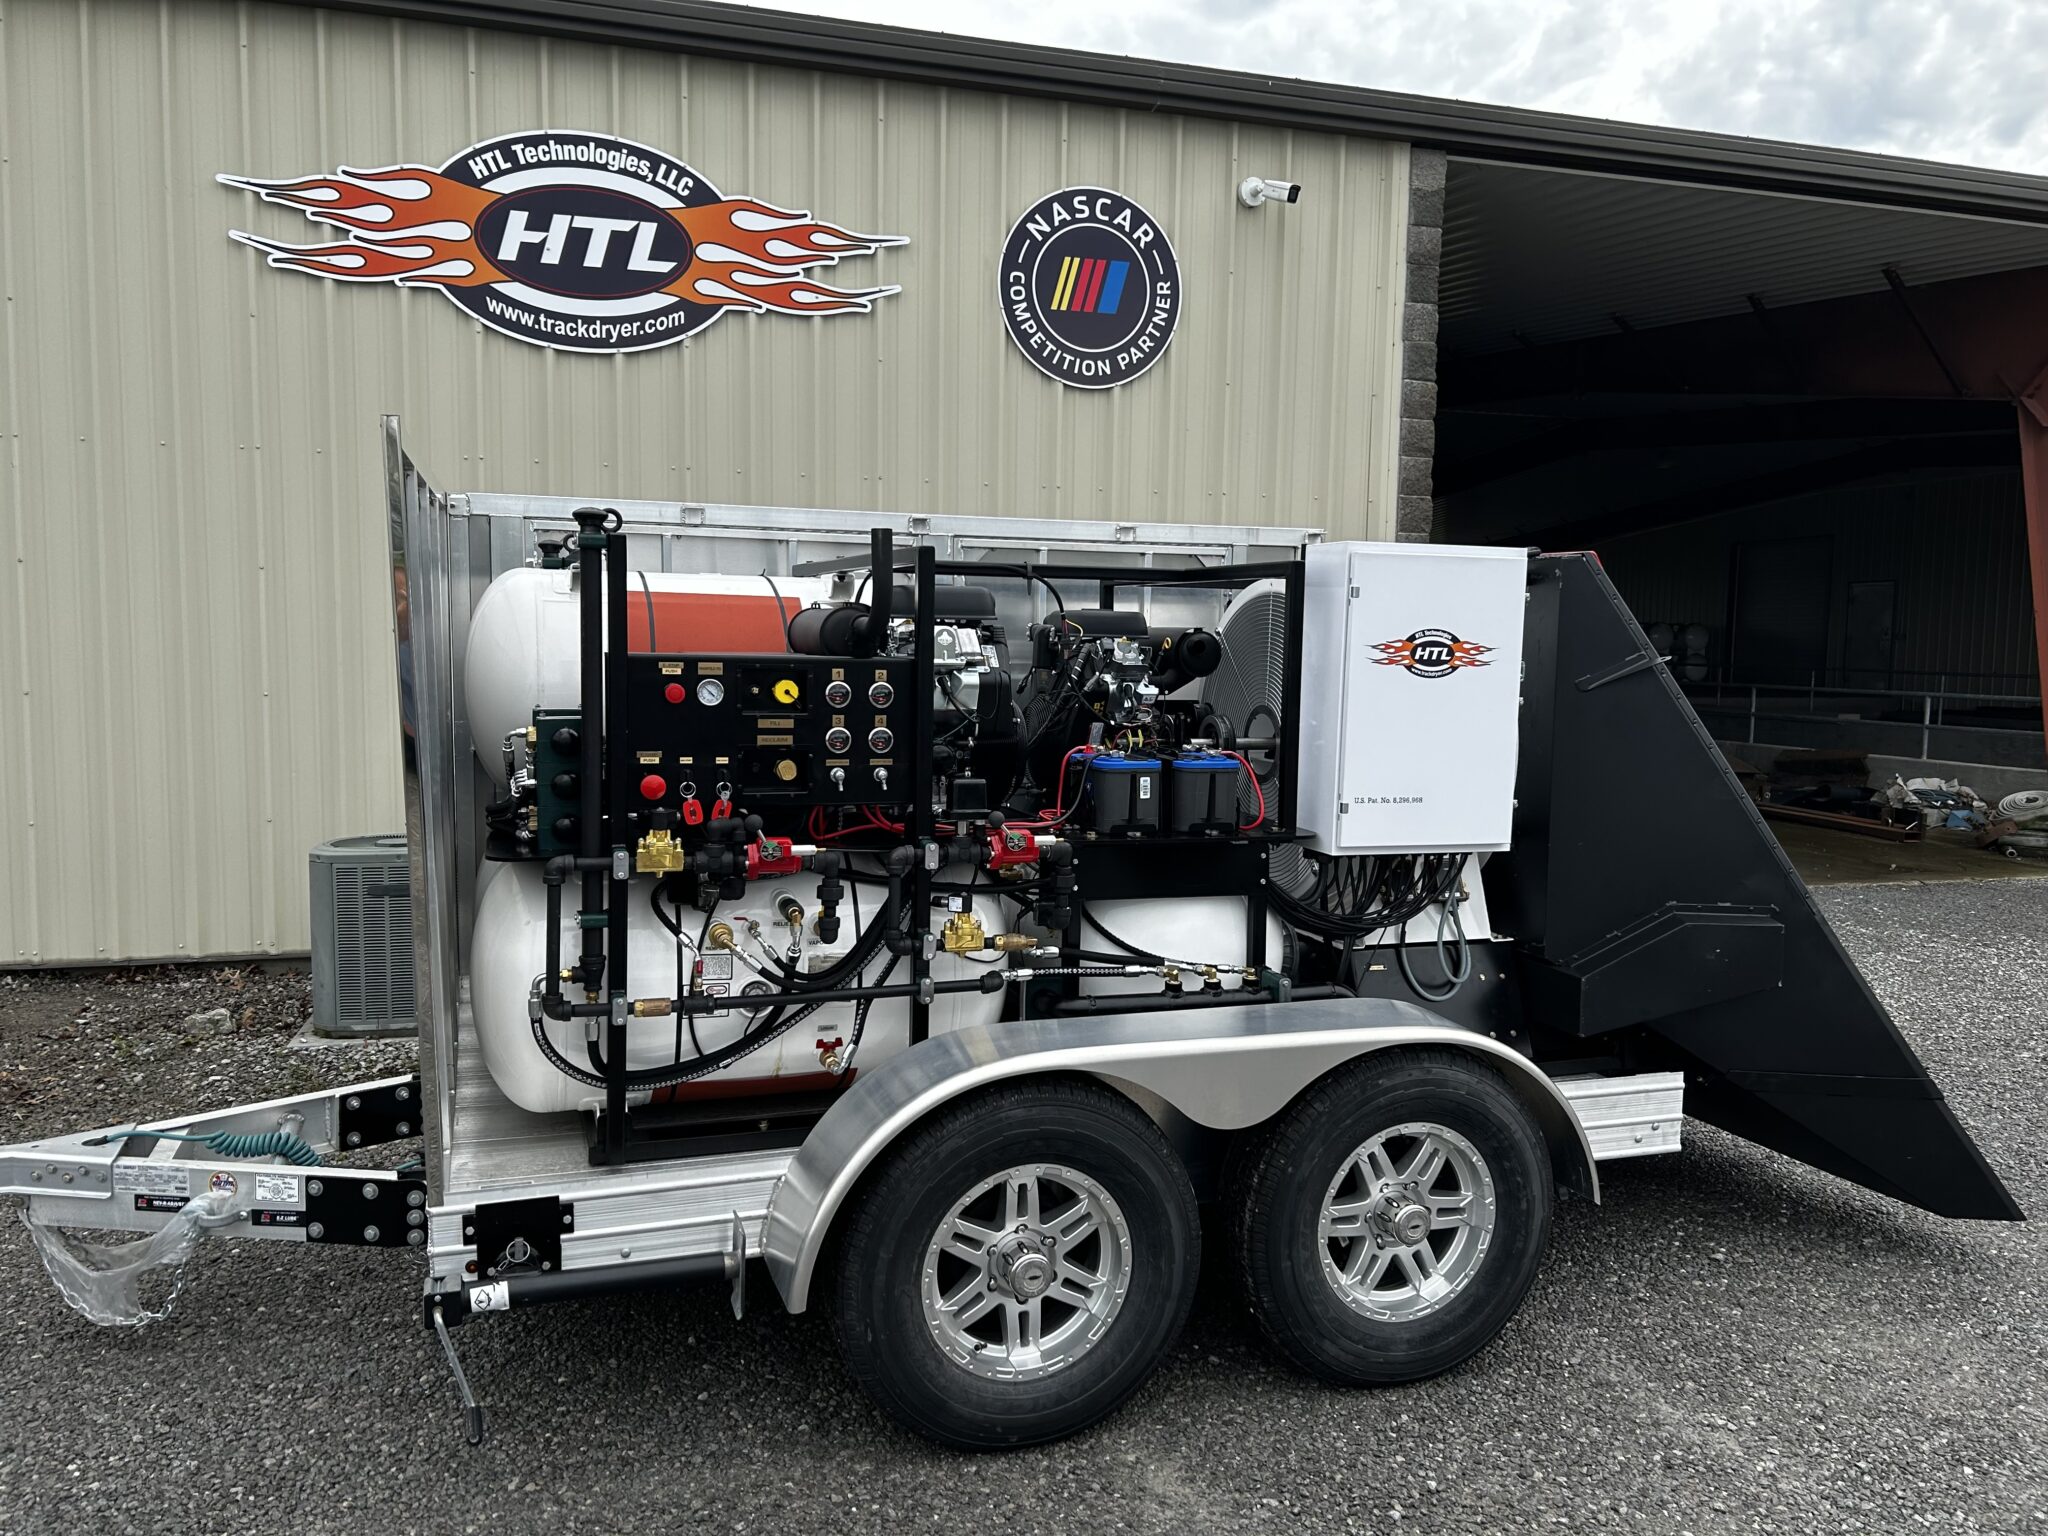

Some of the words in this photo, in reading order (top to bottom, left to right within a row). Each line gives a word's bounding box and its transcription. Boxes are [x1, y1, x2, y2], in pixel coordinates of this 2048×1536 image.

[467, 148, 513, 180] HTL
[511, 139, 655, 182] Technologies,
[654, 162, 695, 197] LLC
[1025, 194, 1155, 249] NASCAR
[495, 208, 679, 274] HTL
[485, 296, 685, 342] www.trackdryer.com
[1009, 270, 1112, 376] COMPETITION
[1116, 280, 1172, 371] PARTNER
[1414, 646, 1452, 661] HTL
[835, 670, 841, 678] 1
[877, 671, 884, 680] 2
[835, 717, 842, 725] 3
[877, 717, 884, 725] 4
